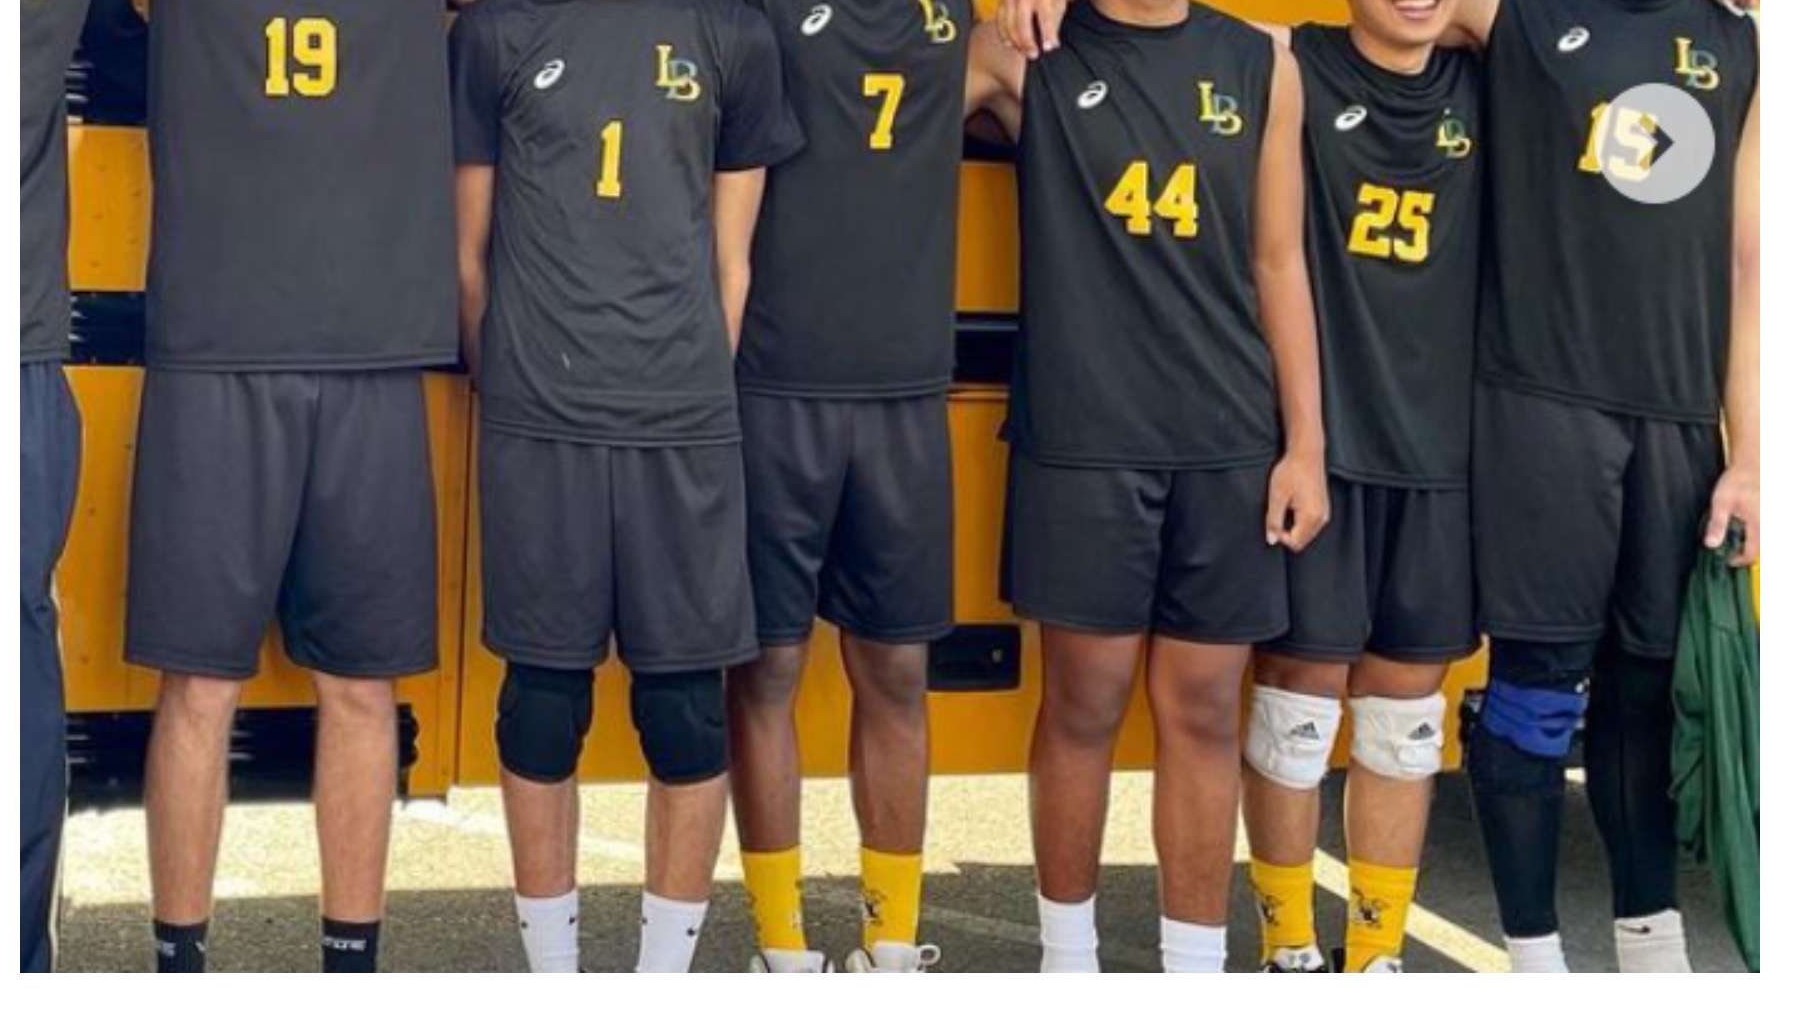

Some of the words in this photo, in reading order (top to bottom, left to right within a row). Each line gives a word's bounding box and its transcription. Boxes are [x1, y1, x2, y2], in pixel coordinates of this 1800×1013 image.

[265, 16, 338, 97] 19
[862, 72, 906, 150] 7
[1577, 102, 1659, 182] 15
[596, 120, 623, 198] 1
[1104, 160, 1199, 237] 44
[1346, 183, 1436, 263] 25
